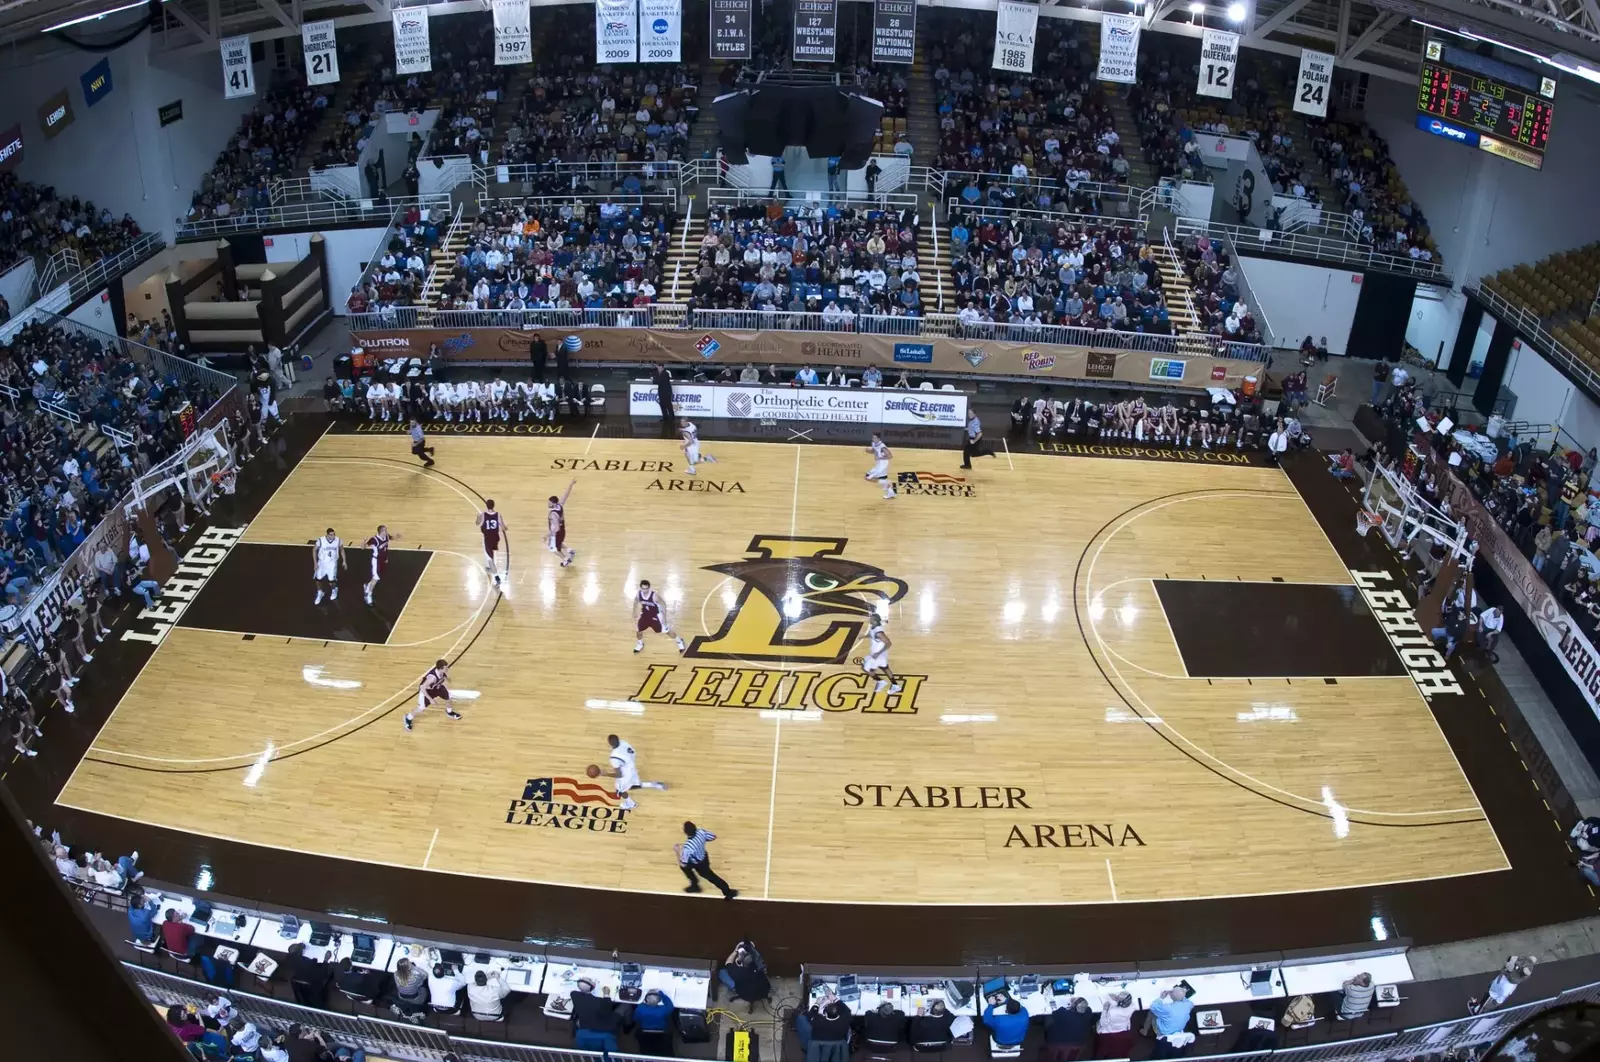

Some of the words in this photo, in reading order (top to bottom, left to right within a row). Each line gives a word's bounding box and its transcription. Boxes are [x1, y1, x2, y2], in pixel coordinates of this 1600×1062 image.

[714, 0, 747, 9] LEHIGH
[799, 2, 832, 11] LEHIGH
[879, 3, 912, 12] LEHIGH
[809, 18, 822, 26] 127
[495, 26, 529, 34] NCAA
[717, 29, 746, 37] E.I.W.A.
[796, 27, 834, 36] WRESTLING
[876, 28, 913, 37] WRESTLING
[877, 38, 911, 47] NATIONAL
[999, 31, 1033, 44] NCAA
[228, 49, 243, 57] ANNE
[499, 41, 526, 53] 1997
[716, 43, 745, 51] TITLES
[795, 47, 834, 55] AMERICANS
[874, 48, 912, 57] CHAMPIONS
[1210, 43, 1231, 53] DAREN
[1002, 48, 1026, 60] 1985
[1203, 49, 1237, 63] QUEENAN
[312, 53, 331, 74] 21
[1001, 57, 1025, 68] 1988
[1309, 63, 1324, 73] MIKE
[1100, 67, 1134, 77] 2003-04
[1206, 64, 1229, 87] 12
[1302, 70, 1329, 84] POLAHA
[90, 75, 105, 92] NAVY
[230, 69, 248, 90] 41
[1300, 83, 1324, 105] 24
[1482, 100, 1489, 110] 2
[46, 105, 66, 126] LEHIGH
[1484, 116, 1497, 128] 42
[1442, 126, 1466, 140] PEPSI
[1511, 124, 1518, 136] 2
[585, 340, 604, 348] at&t
[816, 347, 862, 358] HEALTH
[1023, 352, 1040, 361] RED
[1029, 356, 1055, 370] ROBIN
[632, 391, 660, 402] SERVIC
[672, 393, 702, 403] LECTRIC
[753, 392, 825, 409] Orthopedic
[828, 397, 869, 409] Center
[884, 400, 918, 411] SERVICE
[919, 401, 955, 413] ELECTRIC
[762, 411, 831, 421] COORDINATED
[833, 413, 868, 422] HEALTH
[1038, 442, 1250, 464] LEHIGHSPORTS.COM
[551, 458, 675, 472] STABLER
[645, 478, 747, 493] ARENA
[892, 482, 976, 491] PATRIOT
[894, 489, 977, 498] LEAGUE
[485, 520, 498, 530] 13
[120, 525, 245, 645] LEHIGH
[1350, 569, 1465, 696] LEHIGH
[1558, 625, 1600, 706] LEHIG
[628, 664, 928, 714] LEHIGH
[843, 784, 1033, 809] STABLER
[508, 800, 632, 822] PATRIOT
[504, 811, 628, 834] LEAGUE
[1003, 824, 1147, 848] ARENA
